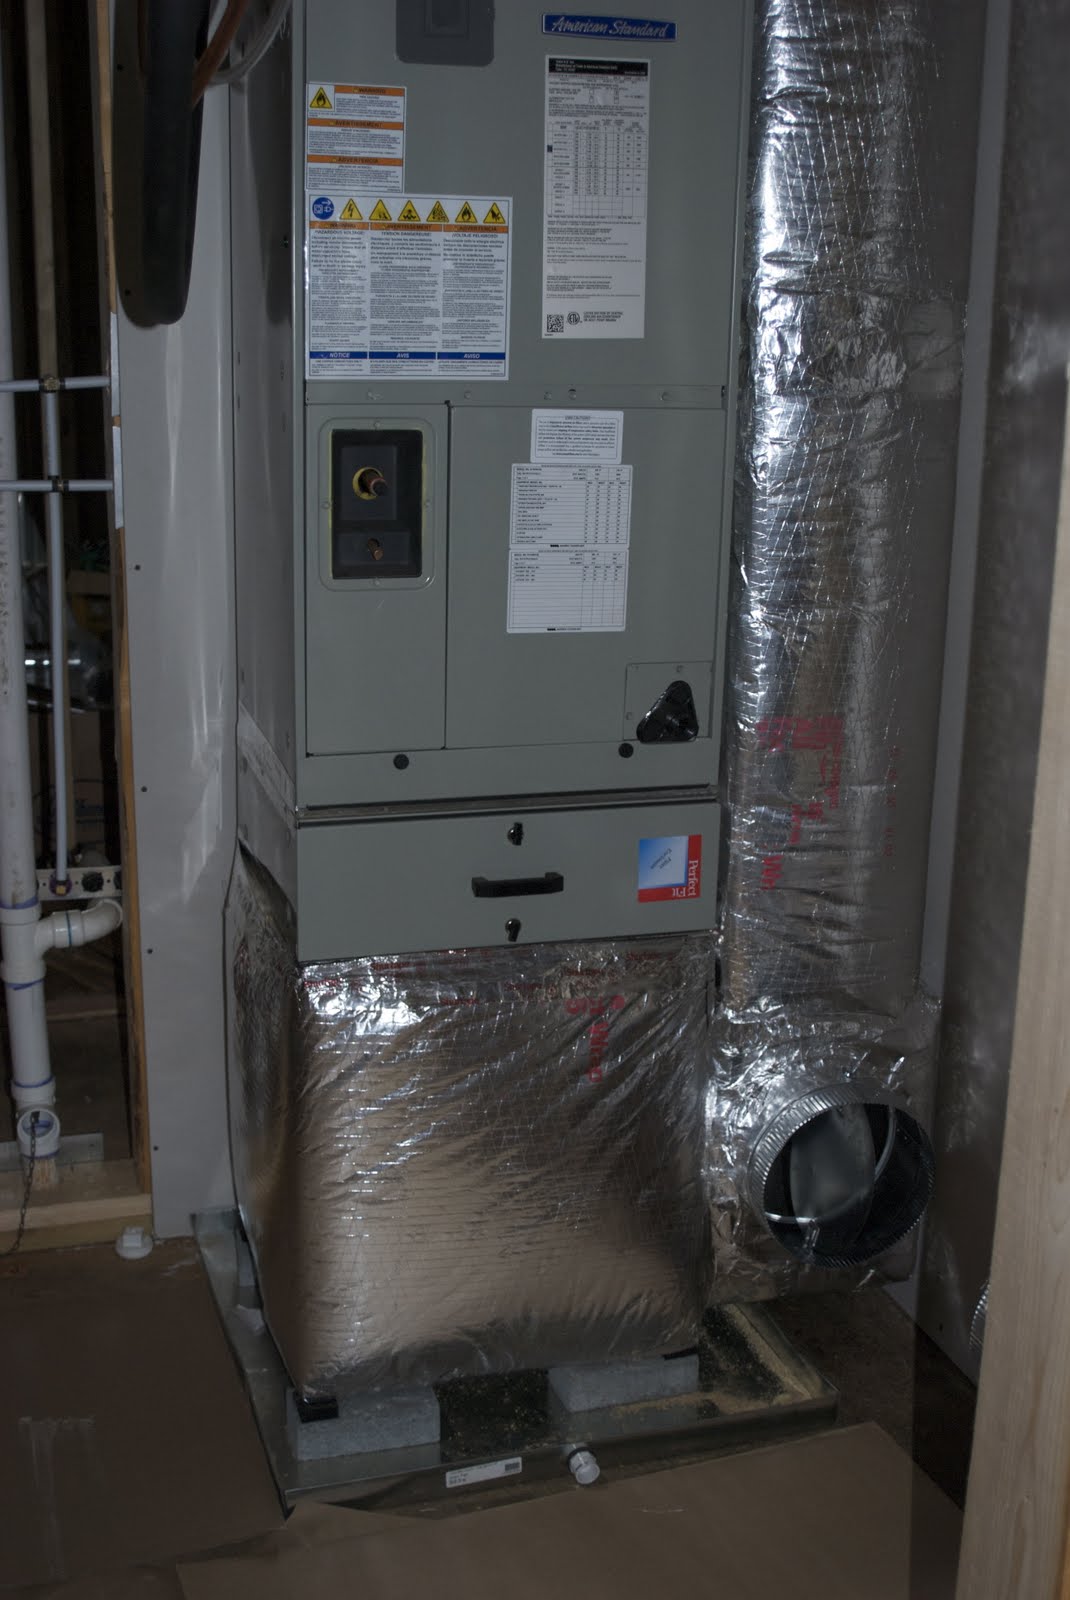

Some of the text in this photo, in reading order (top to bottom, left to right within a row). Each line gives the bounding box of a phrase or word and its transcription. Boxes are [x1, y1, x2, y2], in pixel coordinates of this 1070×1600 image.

[551, 16, 670, 38] American Standard
[687, 860, 699, 896] Perfect
[672, 886, 686, 897] Fit
